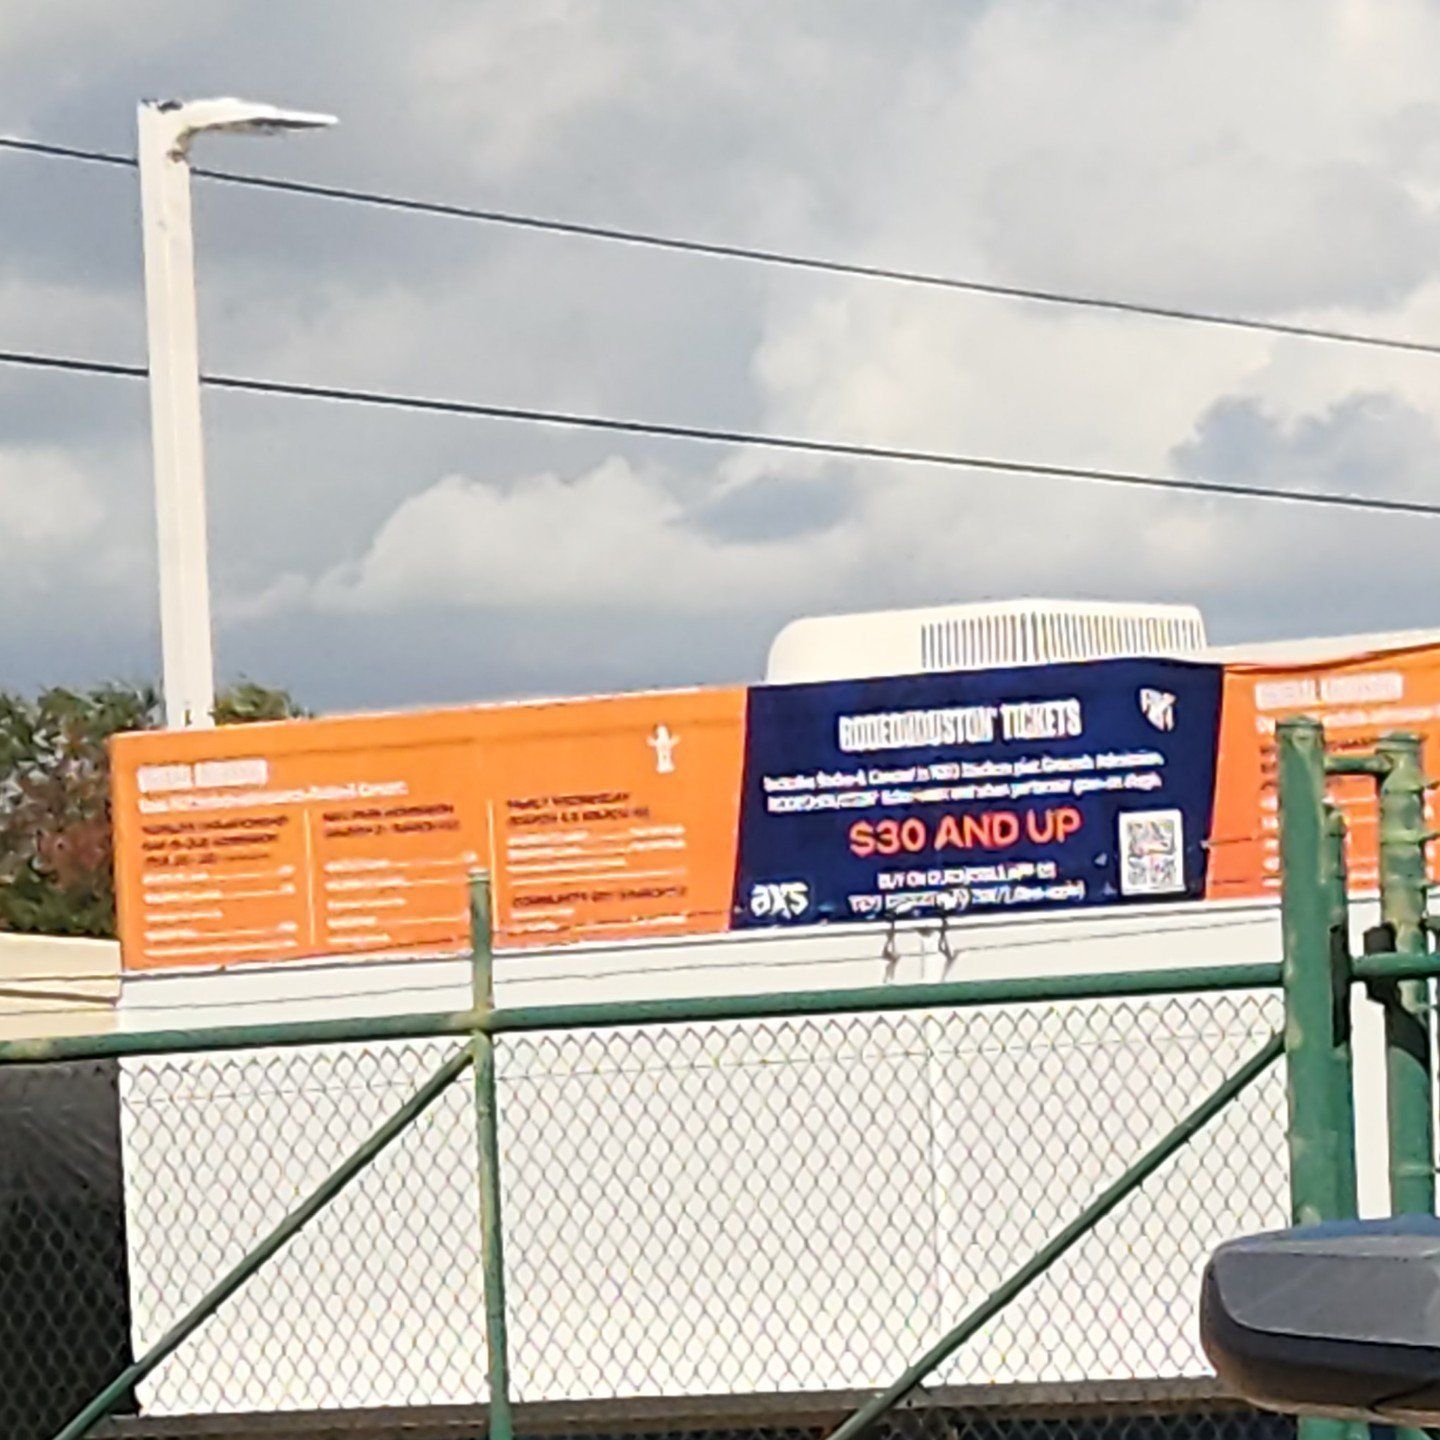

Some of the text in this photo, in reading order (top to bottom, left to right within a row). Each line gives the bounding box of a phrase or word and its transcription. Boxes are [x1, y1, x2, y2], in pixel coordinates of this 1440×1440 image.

[1000, 698, 1082, 740] TICKETS
[934, 812, 1019, 850] AND
[1026, 806, 1083, 845] UP
